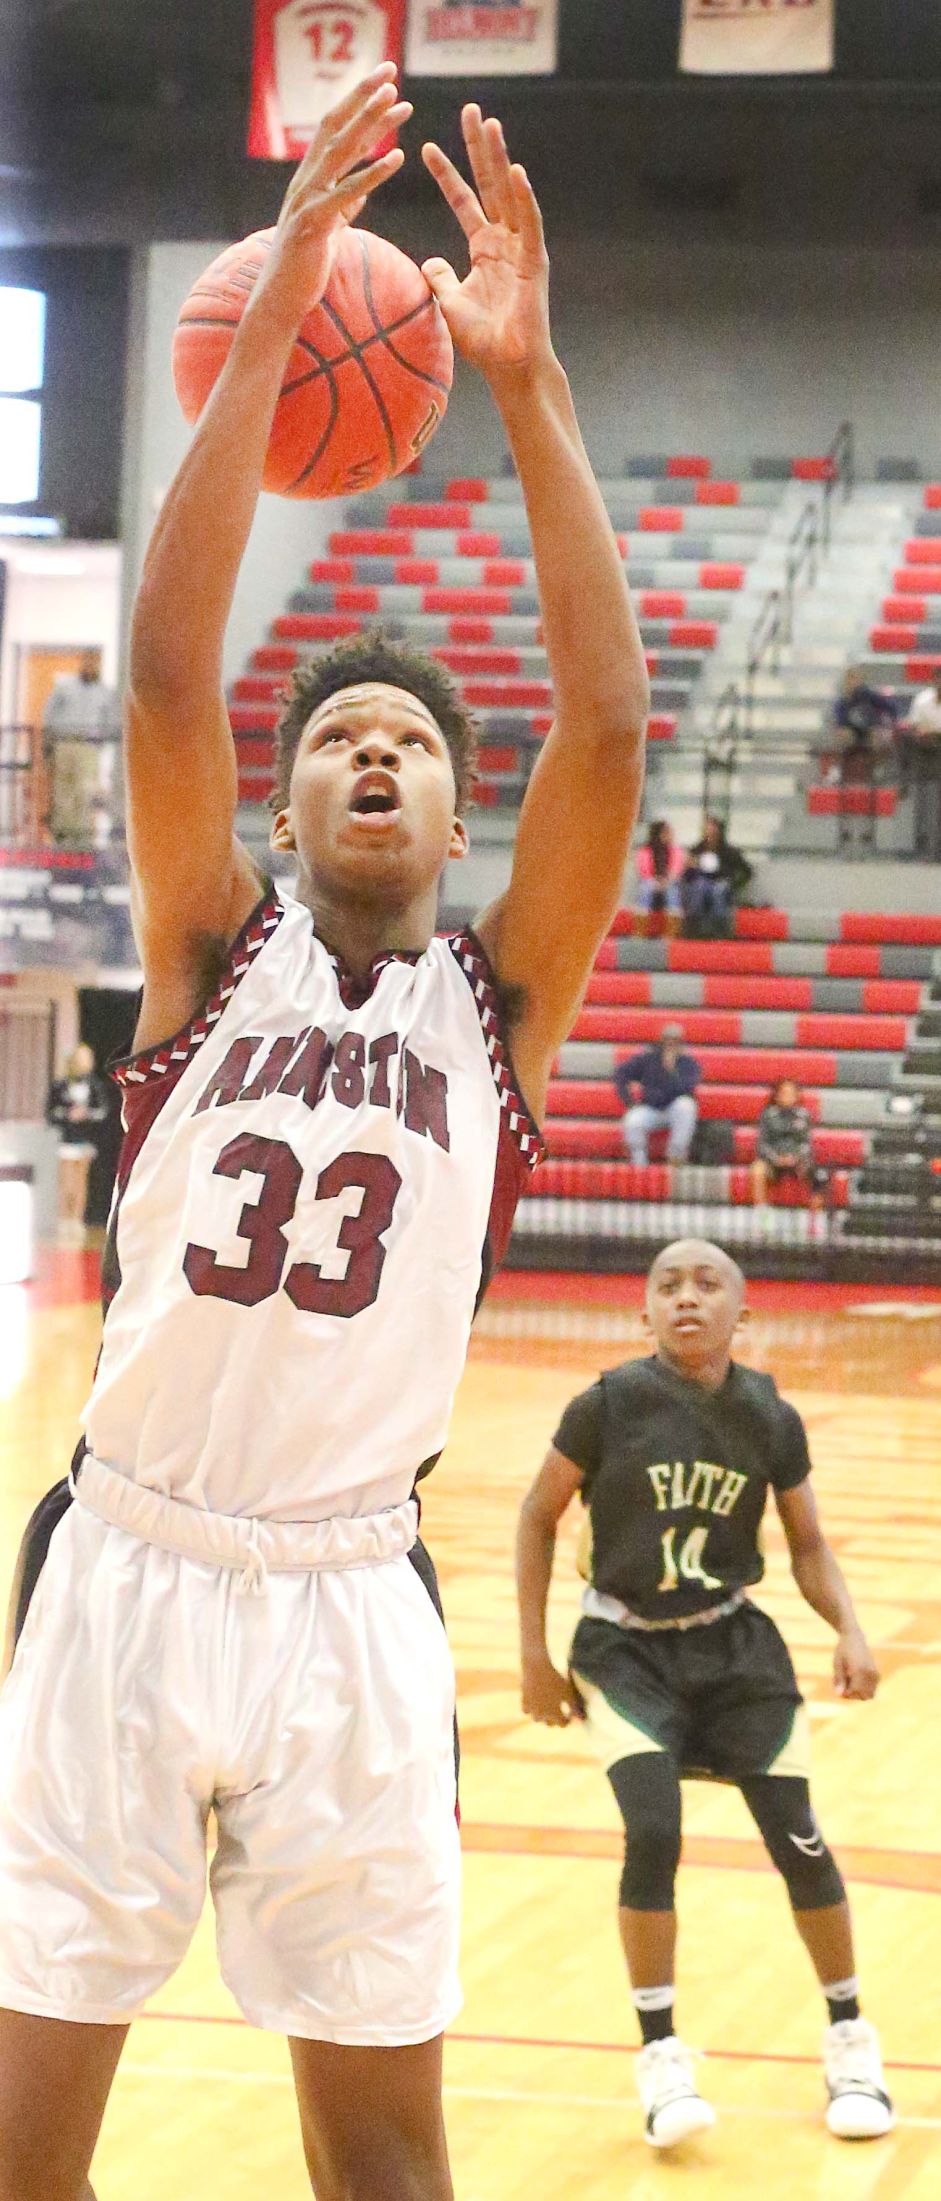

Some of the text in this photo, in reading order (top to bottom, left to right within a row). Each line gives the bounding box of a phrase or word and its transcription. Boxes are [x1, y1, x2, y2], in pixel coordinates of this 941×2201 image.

[304, 20, 353, 62] 12
[182, 1131, 403, 1318] 33
[656, 1525, 724, 1592] 14
